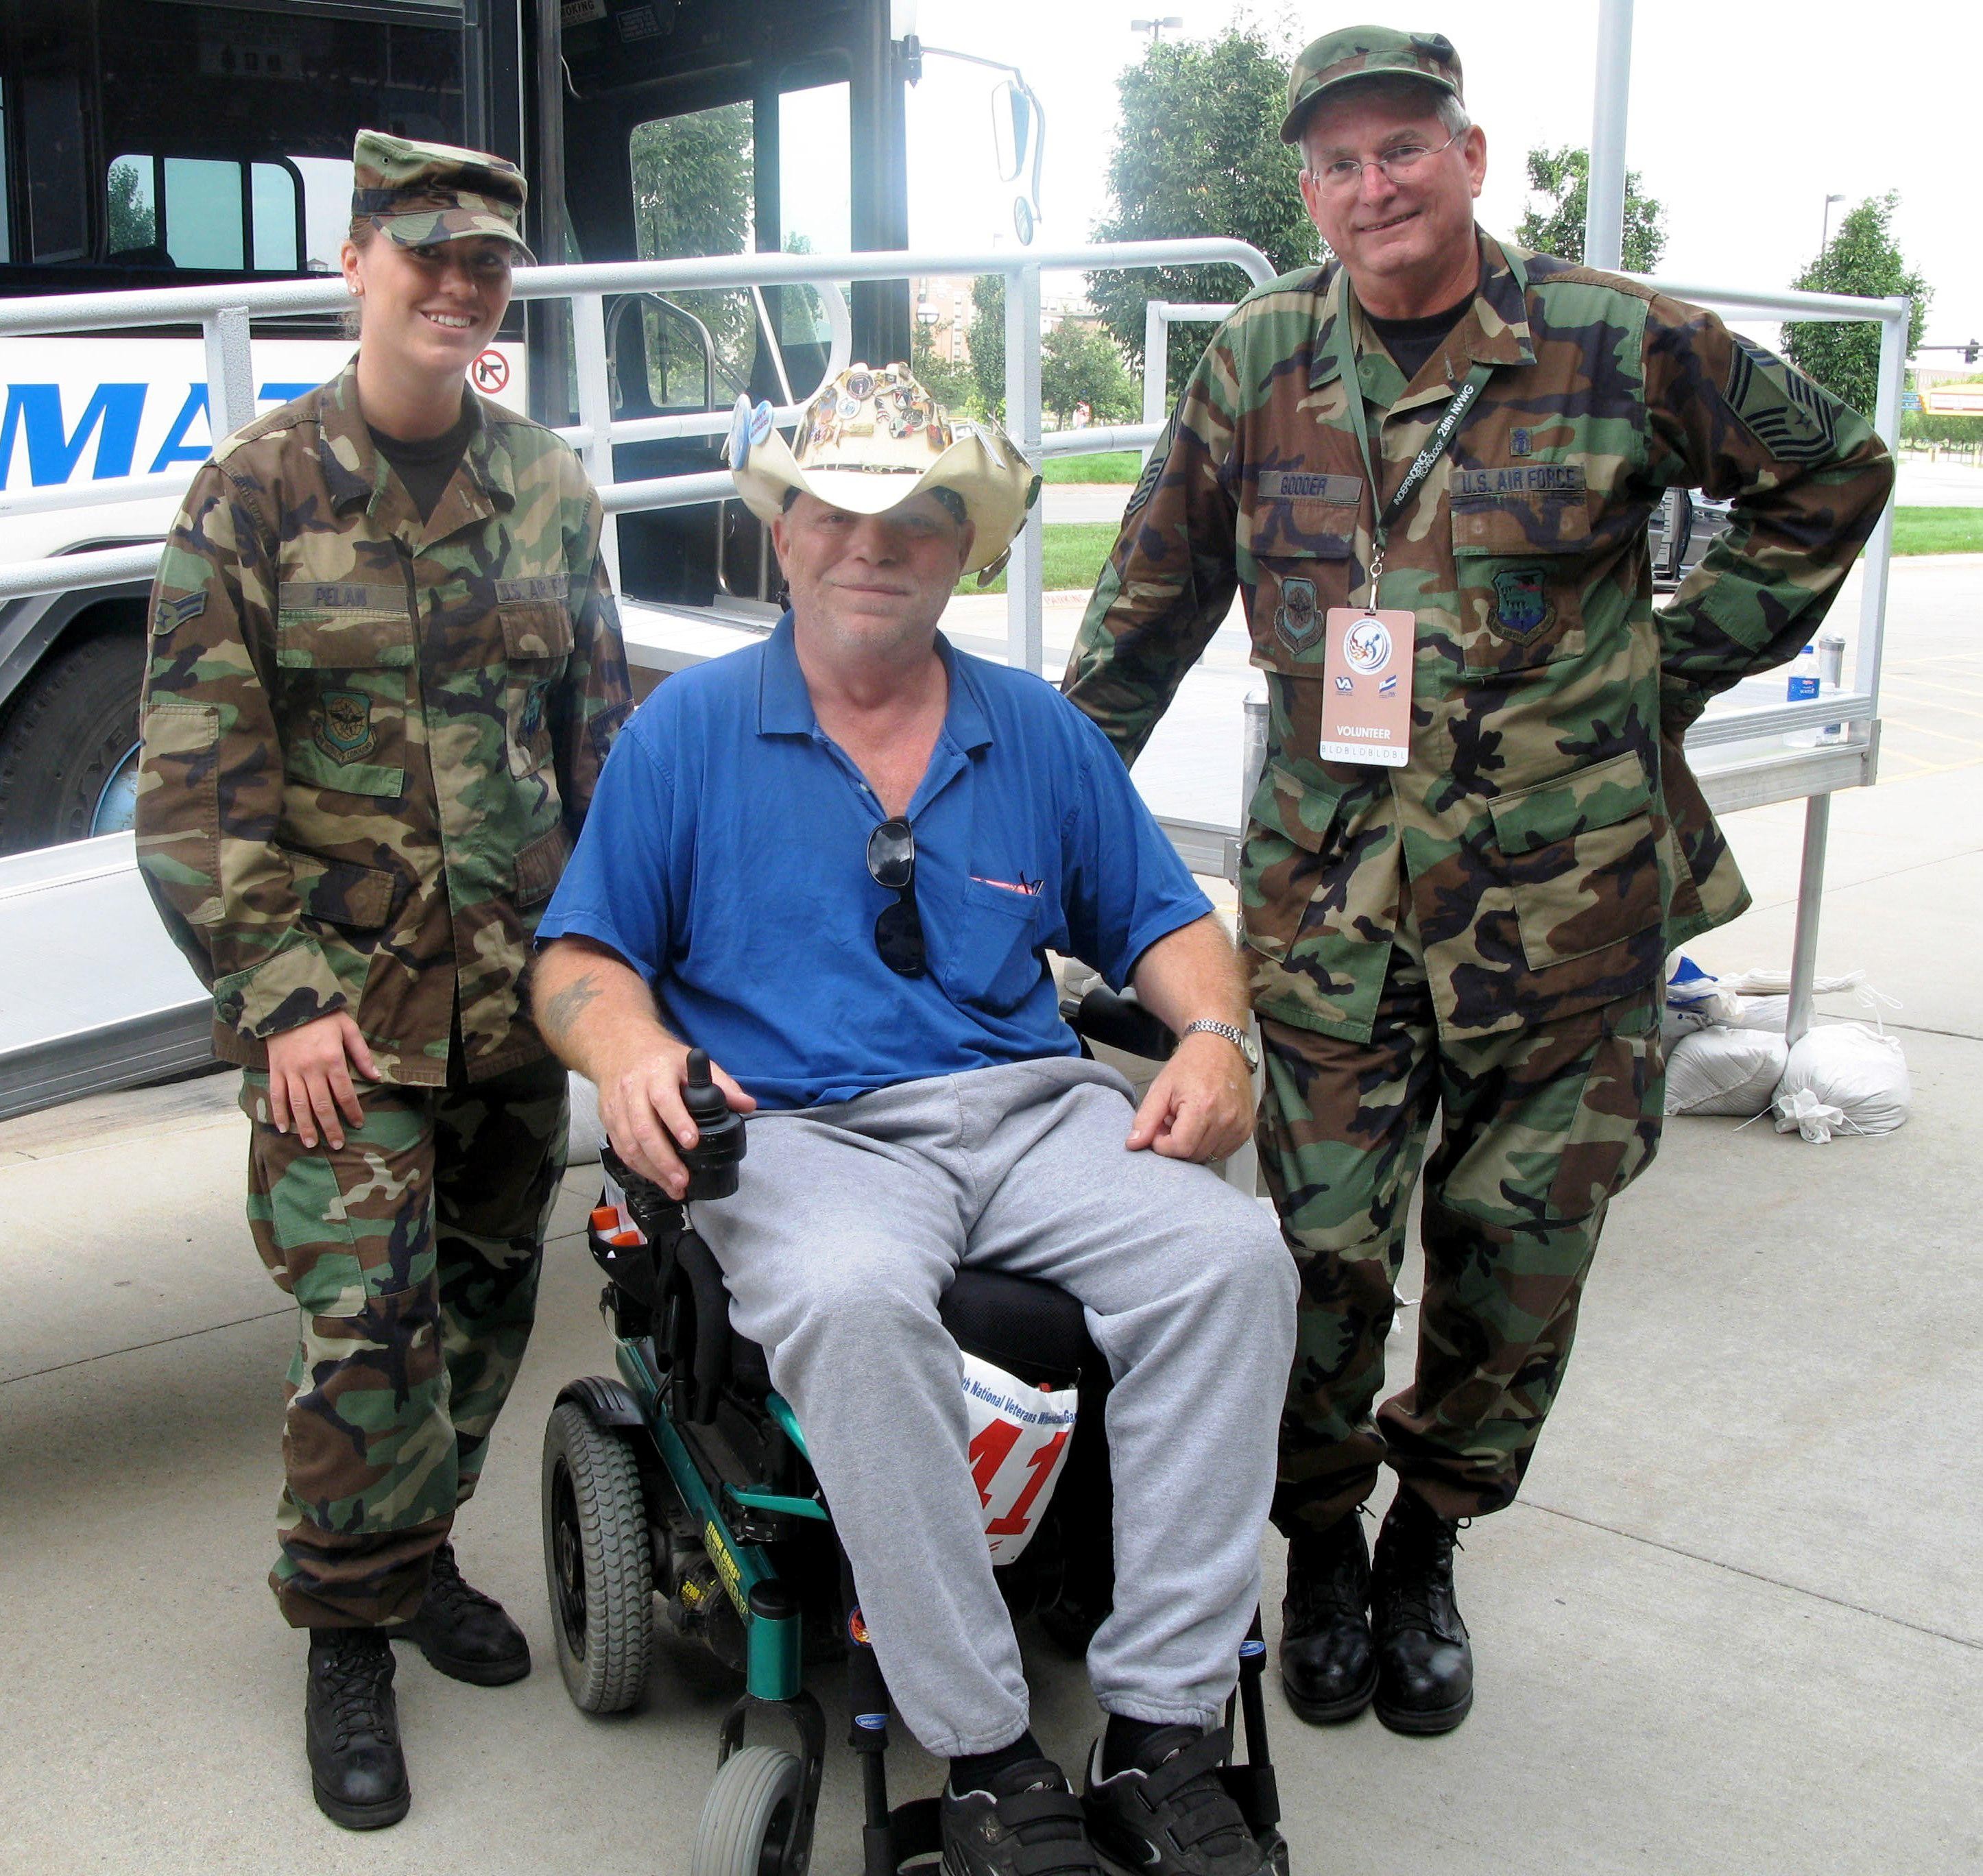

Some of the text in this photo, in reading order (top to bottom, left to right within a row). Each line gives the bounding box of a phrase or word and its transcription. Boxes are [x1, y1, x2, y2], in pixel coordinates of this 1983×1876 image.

[561, 1, 595, 16] OKING
[1437, 384, 1474, 437] 28th NVWG
[0, 383, 326, 491] MA
[1393, 450, 1429, 506] INDEPENDENCE
[1417, 440, 1445, 480] TECHNOLOGY
[1463, 468, 1575, 494] U.S. AIR FORCE
[1336, 725, 1392, 740] VOLUNTEER
[970, 1381, 1006, 1408] National
[1005, 1397, 1037, 1423] Veterans
